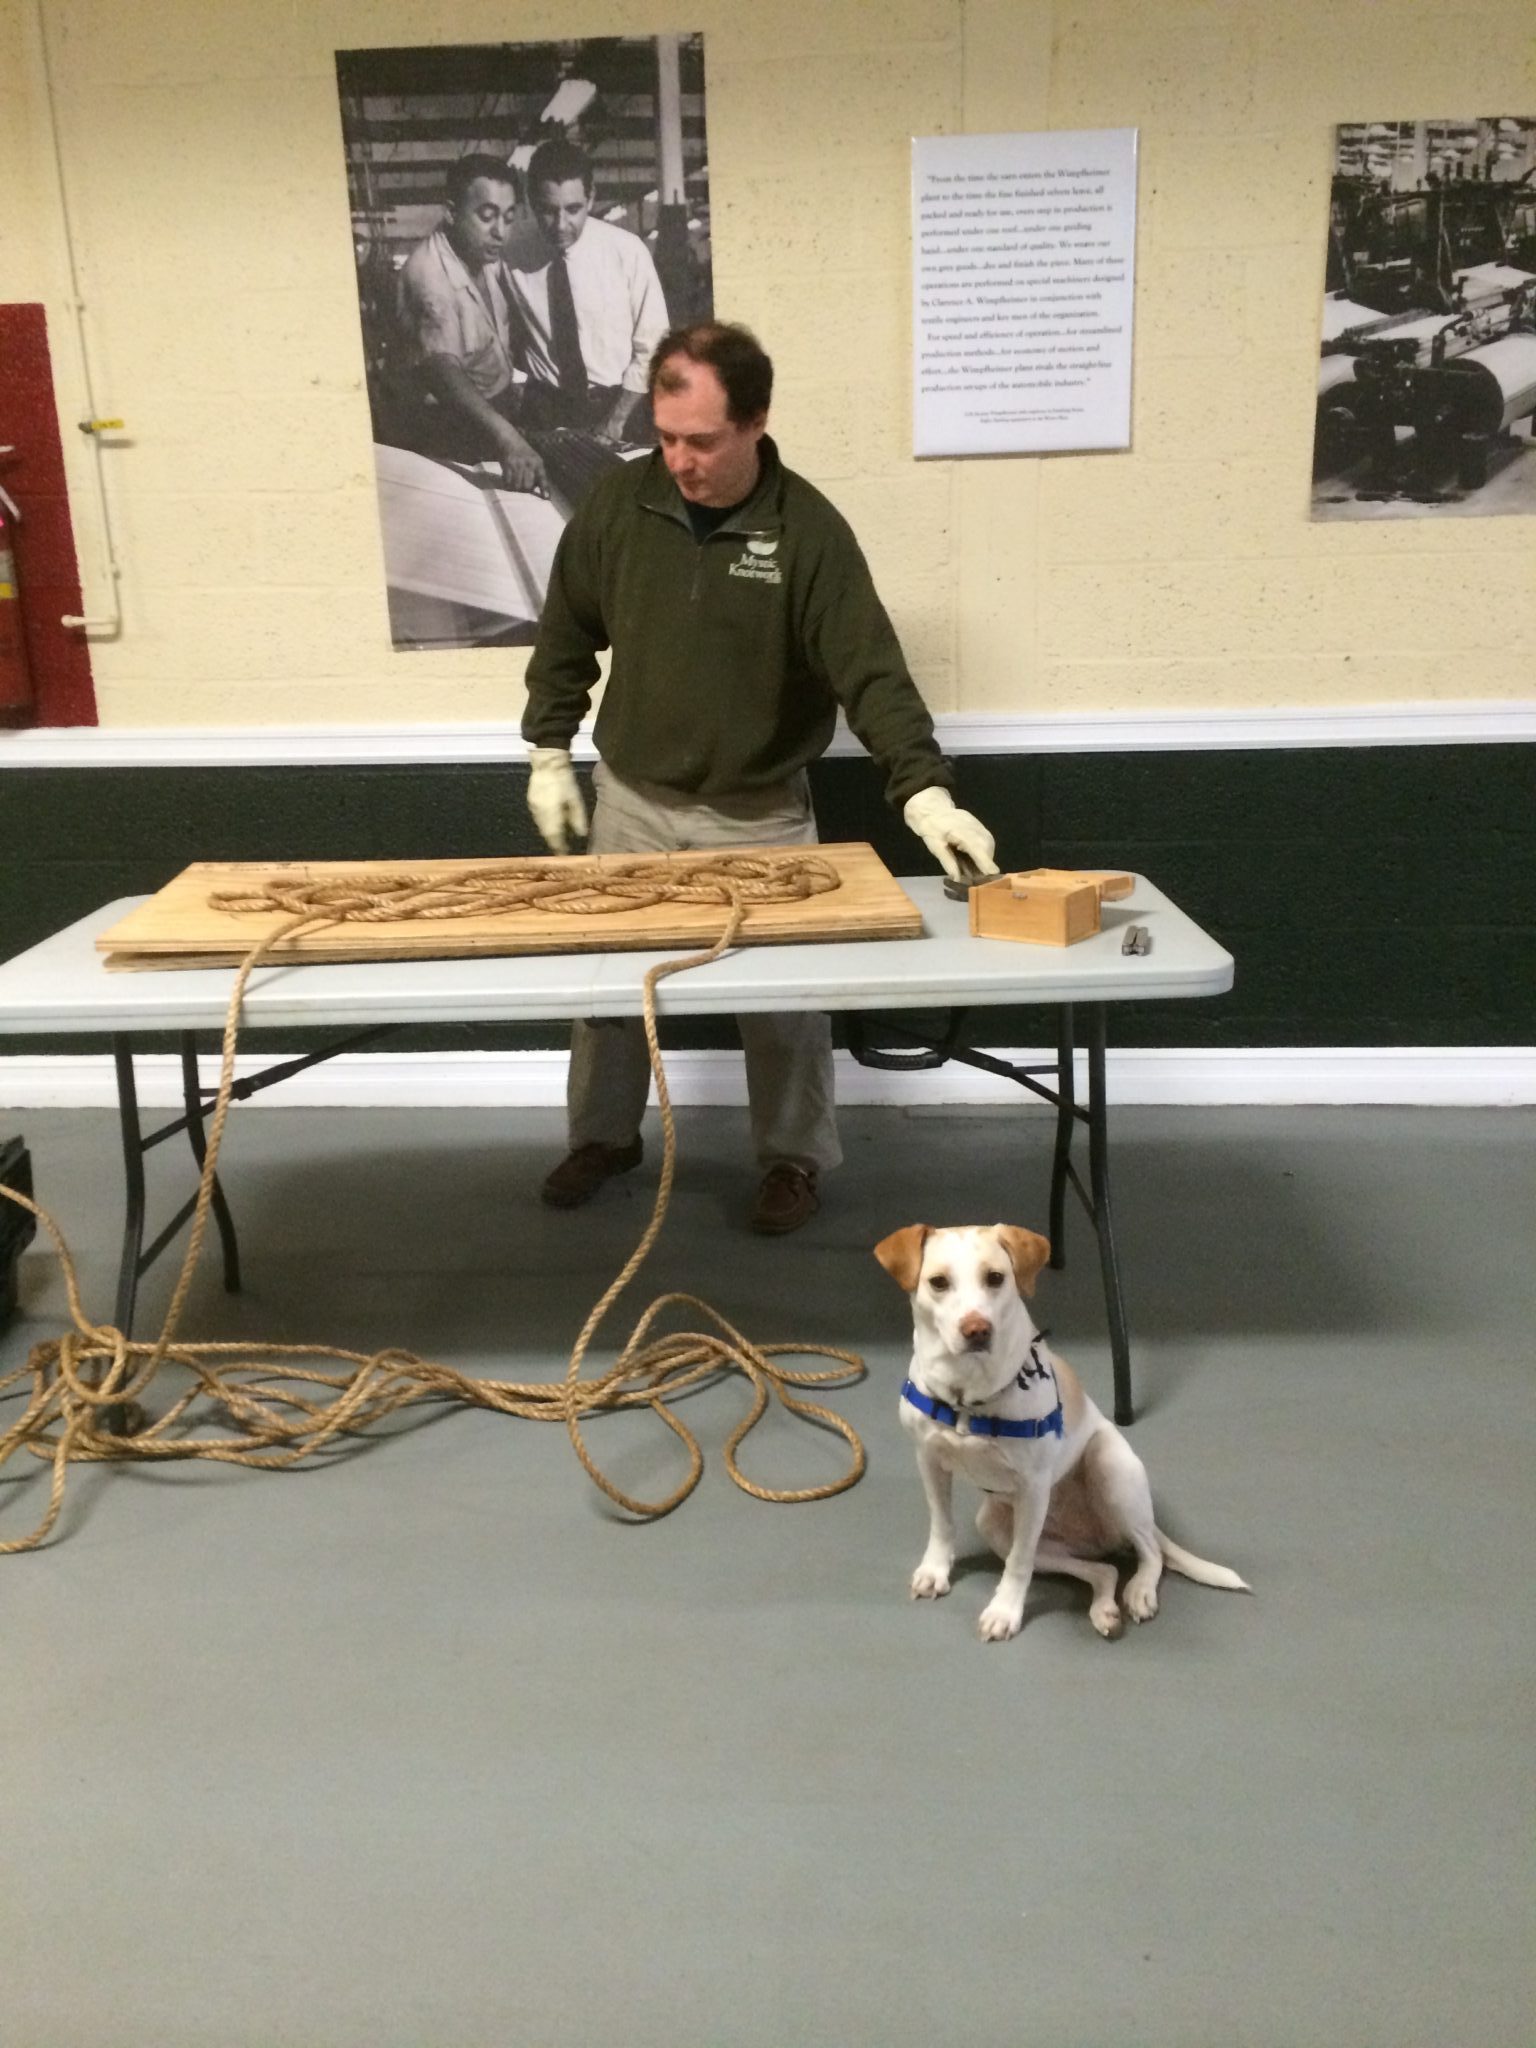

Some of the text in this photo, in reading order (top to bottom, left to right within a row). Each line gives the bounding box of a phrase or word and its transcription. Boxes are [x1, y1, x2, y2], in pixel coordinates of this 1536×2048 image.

[953, 174, 965, 182] the
[967, 173, 984, 181] time
[986, 172, 998, 181] the
[1019, 170, 1041, 179] enters
[1043, 170, 1054, 178] the
[920, 193, 939, 203] plant
[942, 192, 949, 200] to
[951, 192, 963, 200] the
[965, 191, 982, 199] time
[984, 190, 995, 199] the
[998, 190, 1012, 198] fine
[1014, 188, 1044, 197] finished
[1094, 186, 1104, 194] all
[920, 210, 946, 221] packed
[948, 210, 962, 218] and
[964, 209, 983, 219] ready
[986, 208, 997, 217] for
[1016, 208, 1034, 217] every
[1036, 206, 1051, 216] step
[1053, 206, 1061, 214] in
[1063, 204, 1104, 215] production
[1106, 203, 1112, 211] is
[921, 227, 959, 239] performed
[962, 226, 983, 235] under
[1063, 222, 1092, 233] guiding
[986, 243, 1017, 252] standard
[1020, 243, 1027, 251] of
[1058, 241, 1071, 249] We
[997, 261, 1011, 269] and
[1013, 260, 1034, 268] finish
[1036, 259, 1047, 267] the
[1072, 257, 1094, 268] Many
[1096, 257, 1103, 265] of
[1105, 256, 1124, 265] these
[922, 280, 958, 292] operations
[974, 278, 1012, 290] performed
[1026, 277, 1050, 287] special
[1092, 273, 1124, 285] designed
[920, 299, 929, 309] by
[965, 297, 974, 305] A.
[1029, 294, 1037, 302] in
[1039, 292, 1083, 304] conjunction
[1085, 291, 1101, 300] with
[945, 314, 979, 325] engineers
[981, 313, 994, 322] and
[997, 313, 1009, 323] key
[1029, 312, 1036, 320] of
[1039, 311, 1050, 319] the
[927, 333, 939, 341] For
[942, 332, 962, 342] speed
[964, 331, 977, 339] and
[979, 330, 1013, 341] efficiency
[1015, 329, 1022, 337] of
[1079, 325, 1122, 335] streamlined
[921, 349, 961, 361] production
[1013, 348, 1045, 357] economy
[1048, 345, 1055, 353] of
[1057, 344, 1083, 353] motion
[1086, 343, 1100, 352] and
[1014, 363, 1032, 373] plant
[1035, 362, 1053, 370] rivals
[1056, 361, 1066, 370] the
[921, 383, 961, 394] production
[989, 381, 995, 389] of
[998, 381, 1009, 389] the
[1011, 379, 1052, 388] automobile
